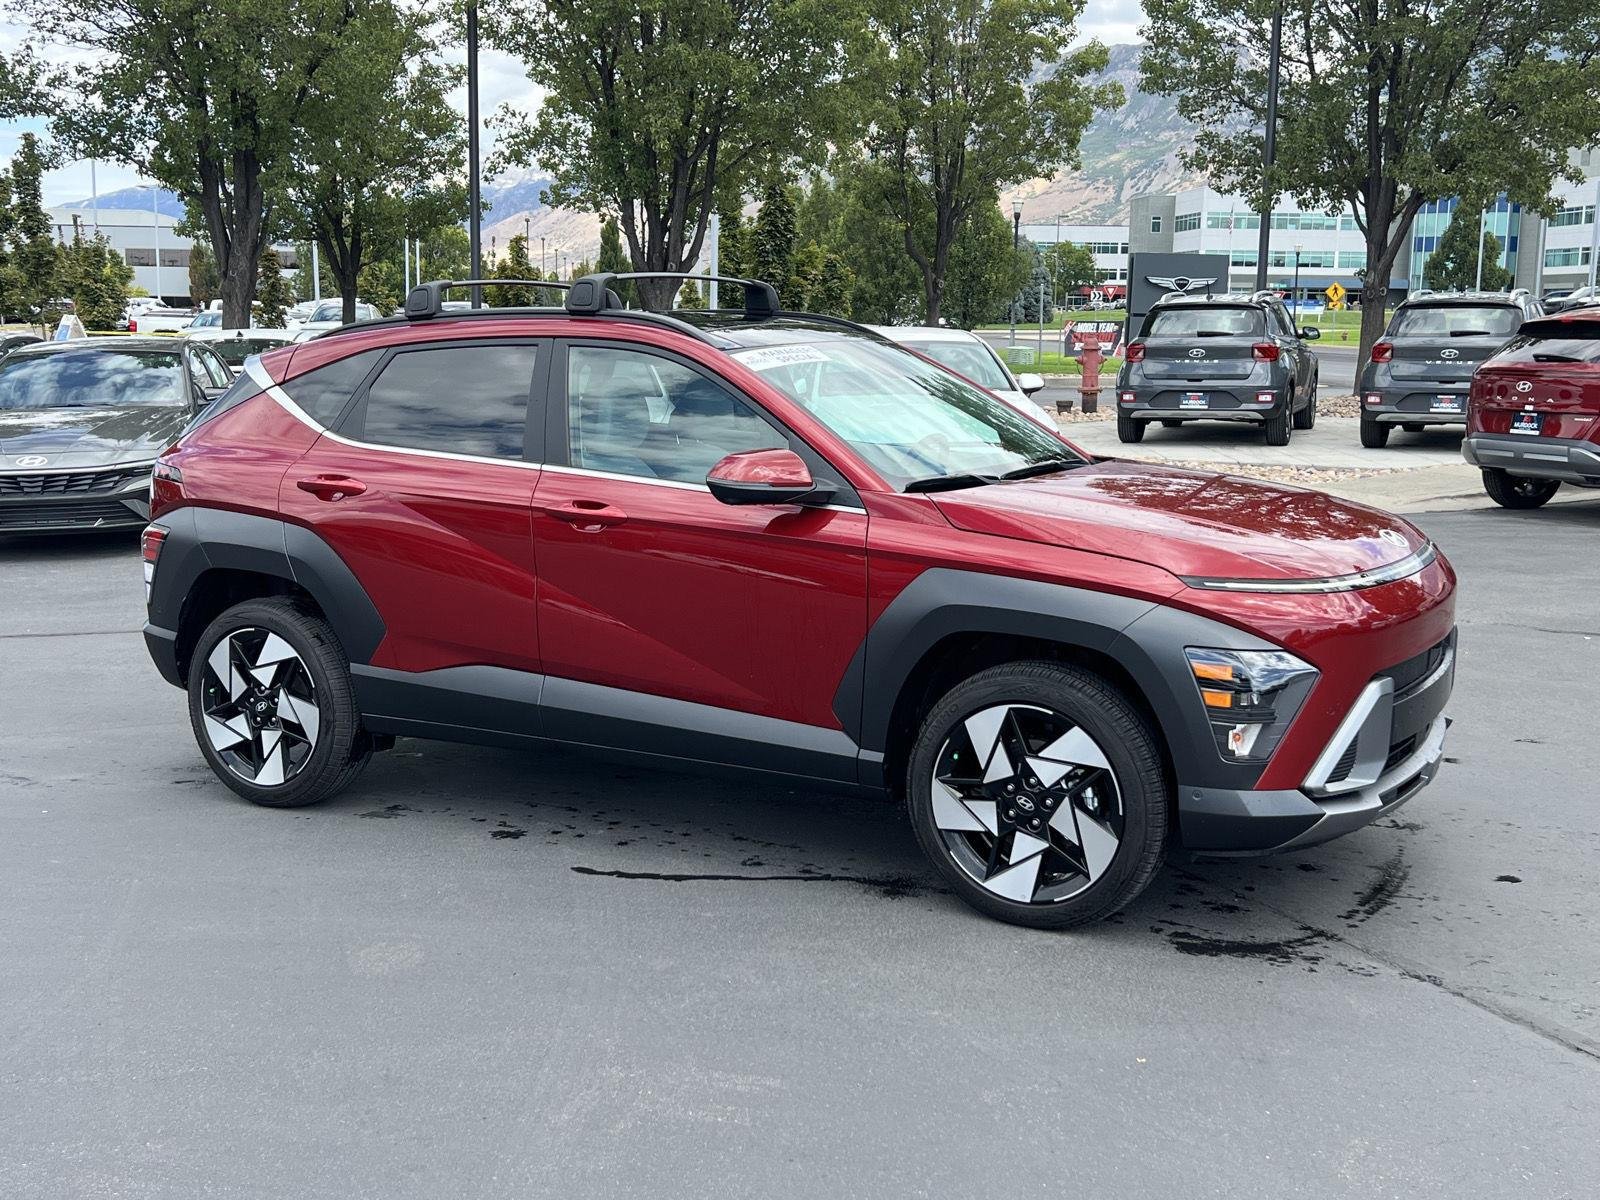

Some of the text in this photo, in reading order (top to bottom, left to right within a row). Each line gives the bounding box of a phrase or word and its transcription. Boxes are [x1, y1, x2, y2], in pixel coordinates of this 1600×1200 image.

[1076, 322, 1115, 332] MODEL YEAR
[1497, 395, 1554, 403] KONA
[1513, 421, 1539, 429] MURDOCK
